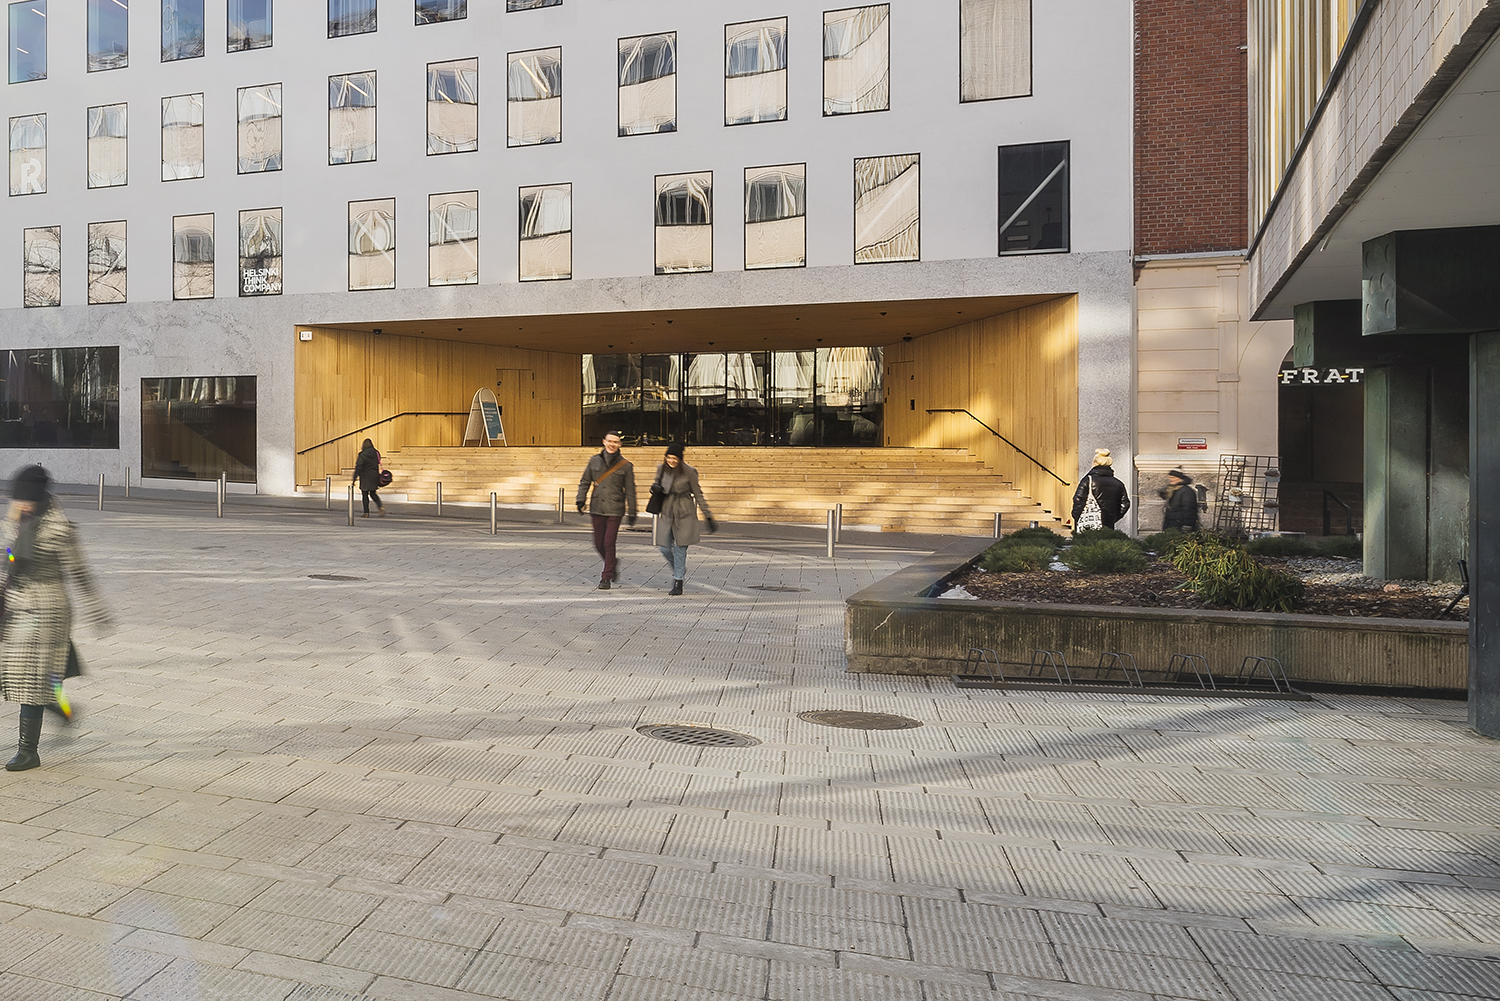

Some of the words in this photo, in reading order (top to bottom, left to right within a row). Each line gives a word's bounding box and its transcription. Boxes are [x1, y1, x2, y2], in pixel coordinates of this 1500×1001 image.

[243, 268, 279, 277] HELSINKI
[243, 276, 268, 285] THINK
[243, 283, 282, 293] COMPANY
[1281, 368, 1364, 384] FRAT
